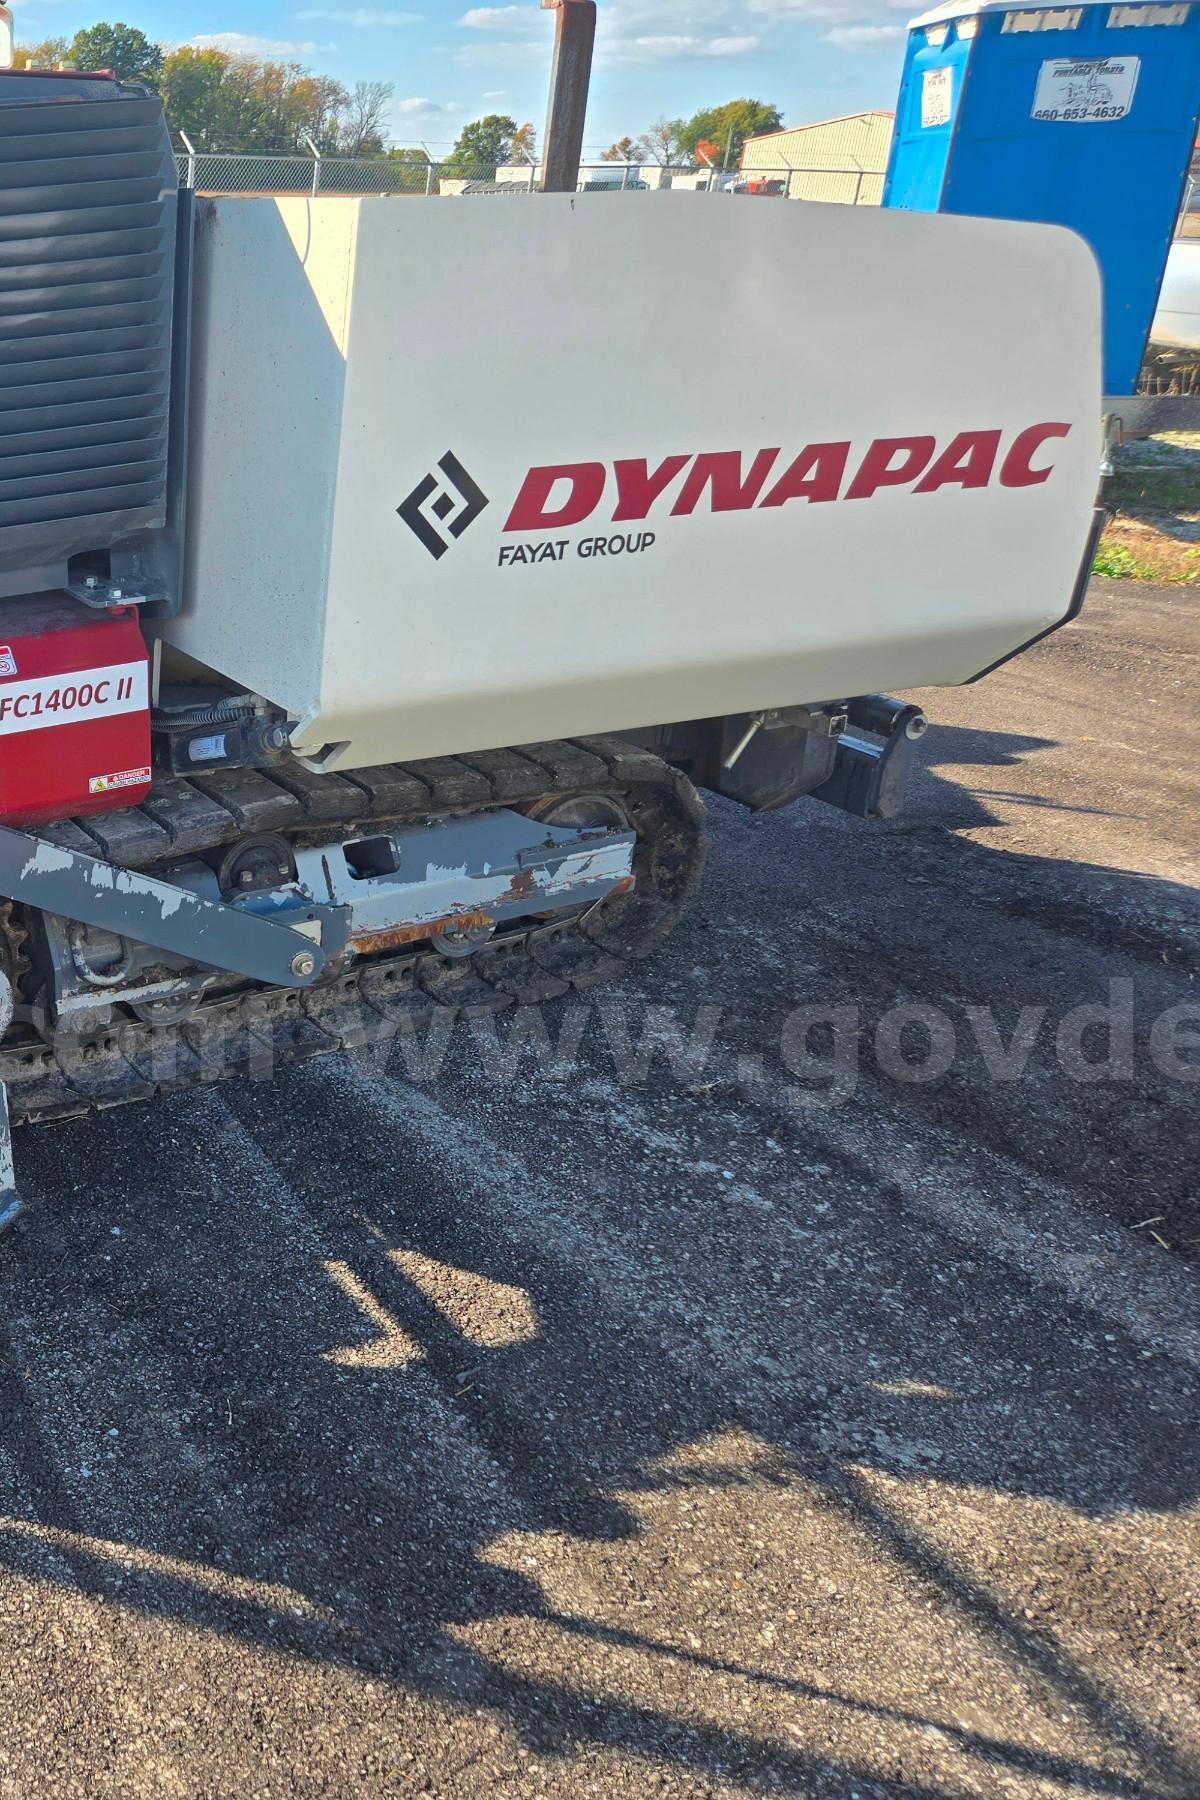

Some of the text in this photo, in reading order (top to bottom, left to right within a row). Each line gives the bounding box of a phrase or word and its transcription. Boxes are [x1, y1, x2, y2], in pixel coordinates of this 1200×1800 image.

[502, 421, 1072, 532] DYNAPAC
[498, 532, 656, 566] FAYAT GROUP
[0, 677, 133, 721] FC1400C II
